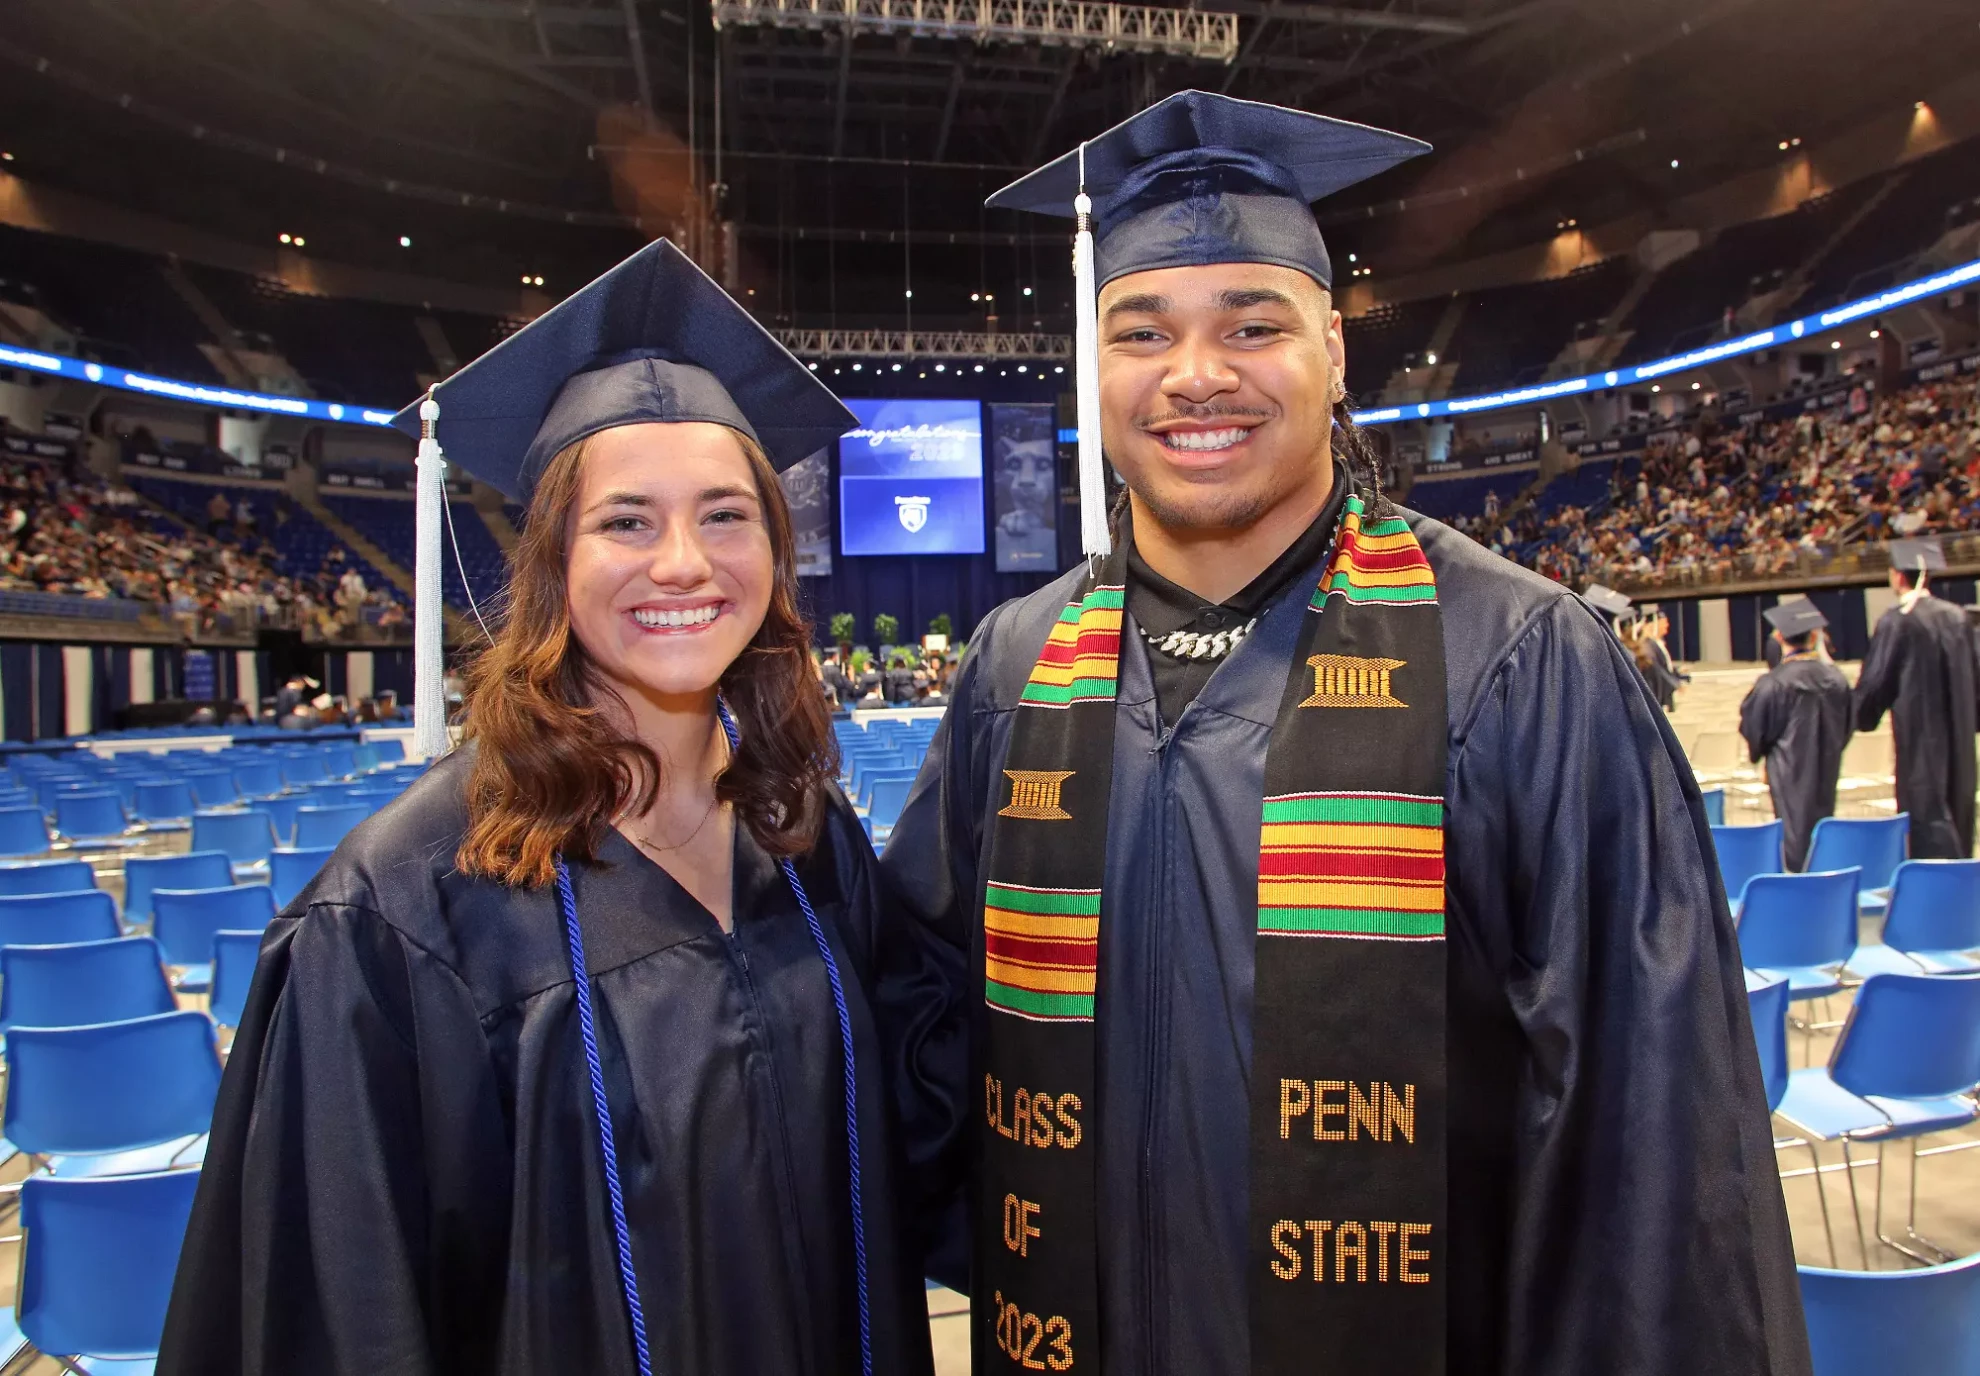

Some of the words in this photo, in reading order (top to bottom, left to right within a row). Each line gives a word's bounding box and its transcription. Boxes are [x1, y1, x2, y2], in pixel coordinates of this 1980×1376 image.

[985, 1072, 1082, 1149] CLASS
[1279, 1077, 1416, 1145] PENN
[1004, 1193, 1042, 1258] OF
[1270, 1218, 1433, 1284] STATE
[995, 1290, 1074, 1371] 2023
